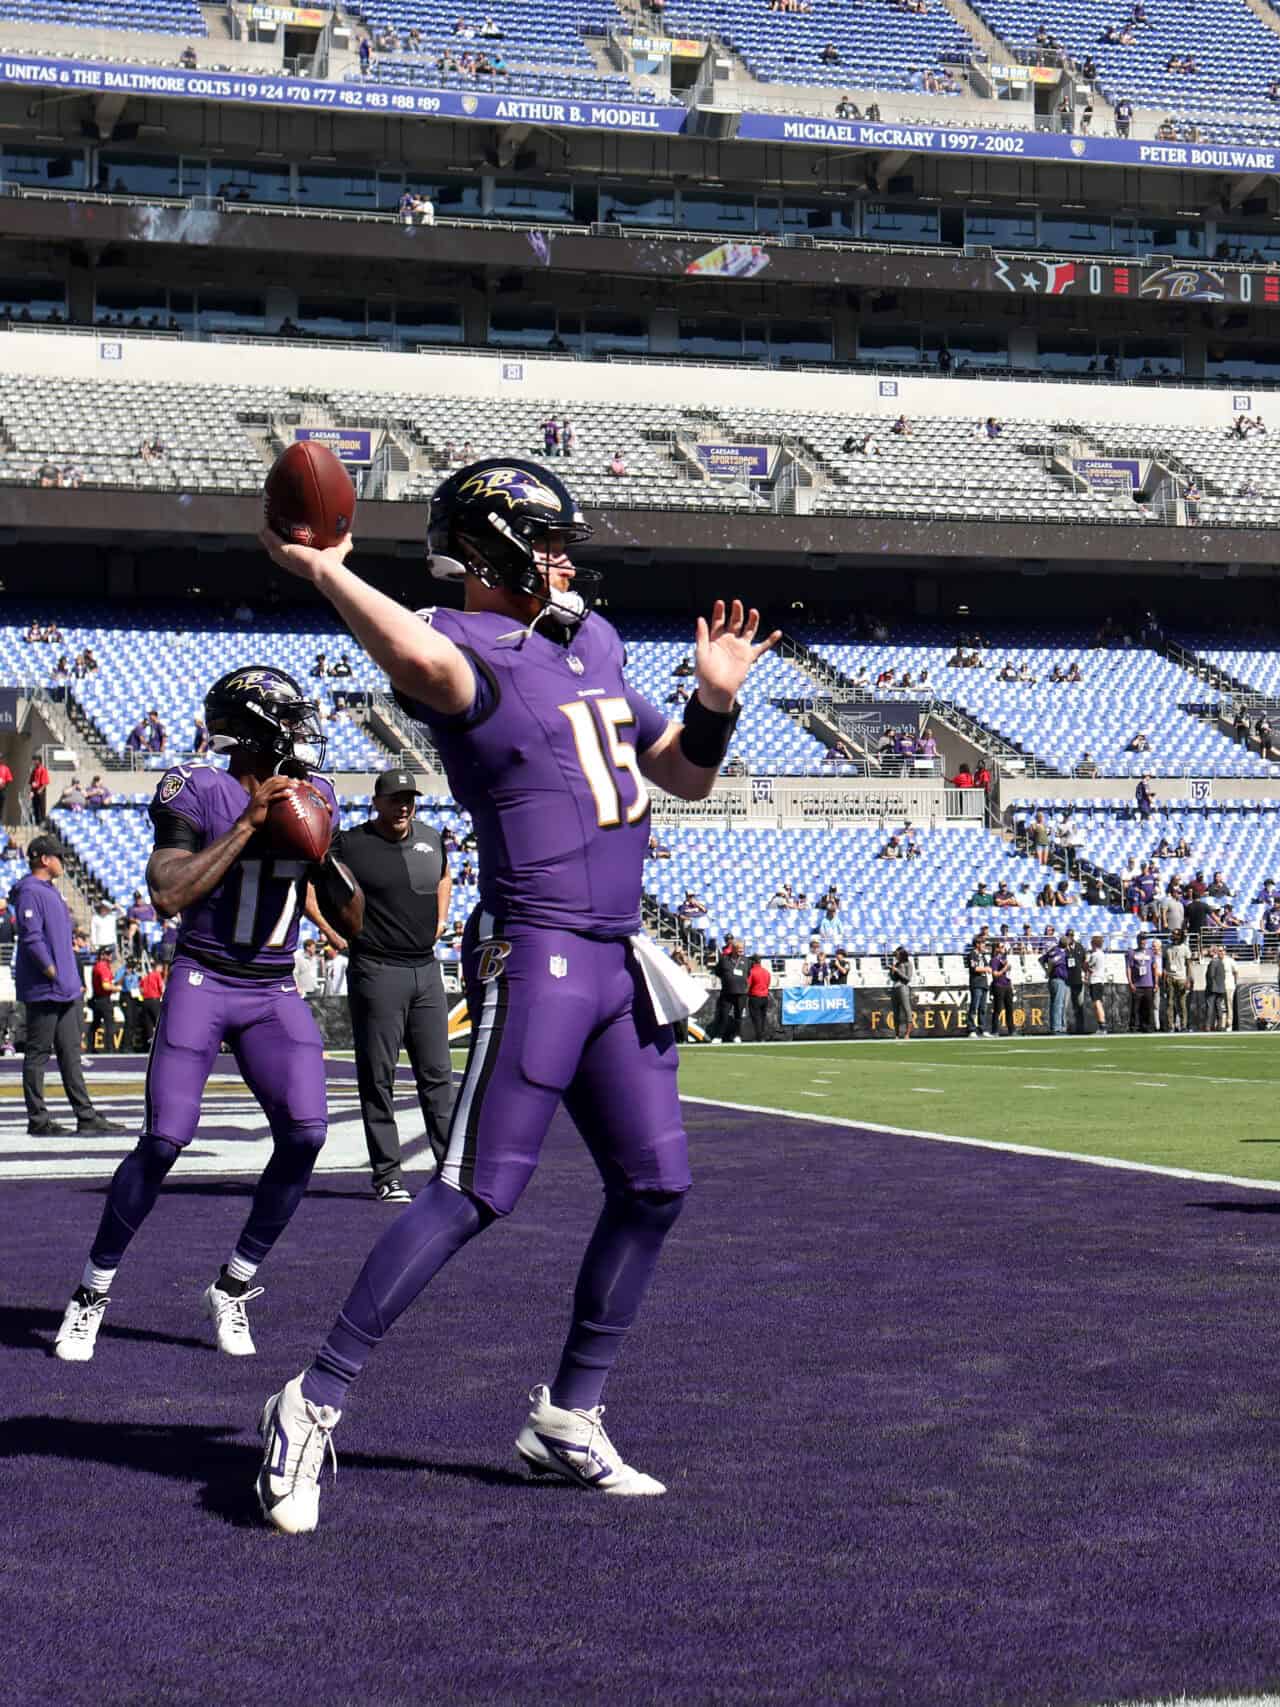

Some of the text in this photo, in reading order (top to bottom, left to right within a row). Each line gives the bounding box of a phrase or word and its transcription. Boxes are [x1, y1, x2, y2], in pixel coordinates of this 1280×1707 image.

[5, 63, 57, 82] UNITAS
[72, 69, 100, 85] THE
[104, 72, 184, 92] BALTIMORE
[188, 80, 231, 96] COLTS
[234, 82, 257, 97] #19
[260, 84, 283, 99] #24
[287, 86, 310, 101] #70
[313, 88, 336, 103] #77
[340, 90, 362, 105] #82
[366, 92, 388, 107] #83
[392, 95, 414, 109] #88
[418, 97, 440, 111] #89
[496, 101, 659, 128] ARTHUR B. MODELL
[783, 123, 1024, 152] MICHAEL McCRARY 1997-2002
[1140, 146, 1187, 163] PETER
[1191, 150, 1275, 169] BOULWARE
[1089, 265, 1100, 294] 0
[1240, 274, 1251, 301] 0
[557, 697, 649, 828] 15
[1191, 783, 1209, 800] 152
[233, 860, 306, 947] 17
[796, 998, 850, 1011] CBS NFL
